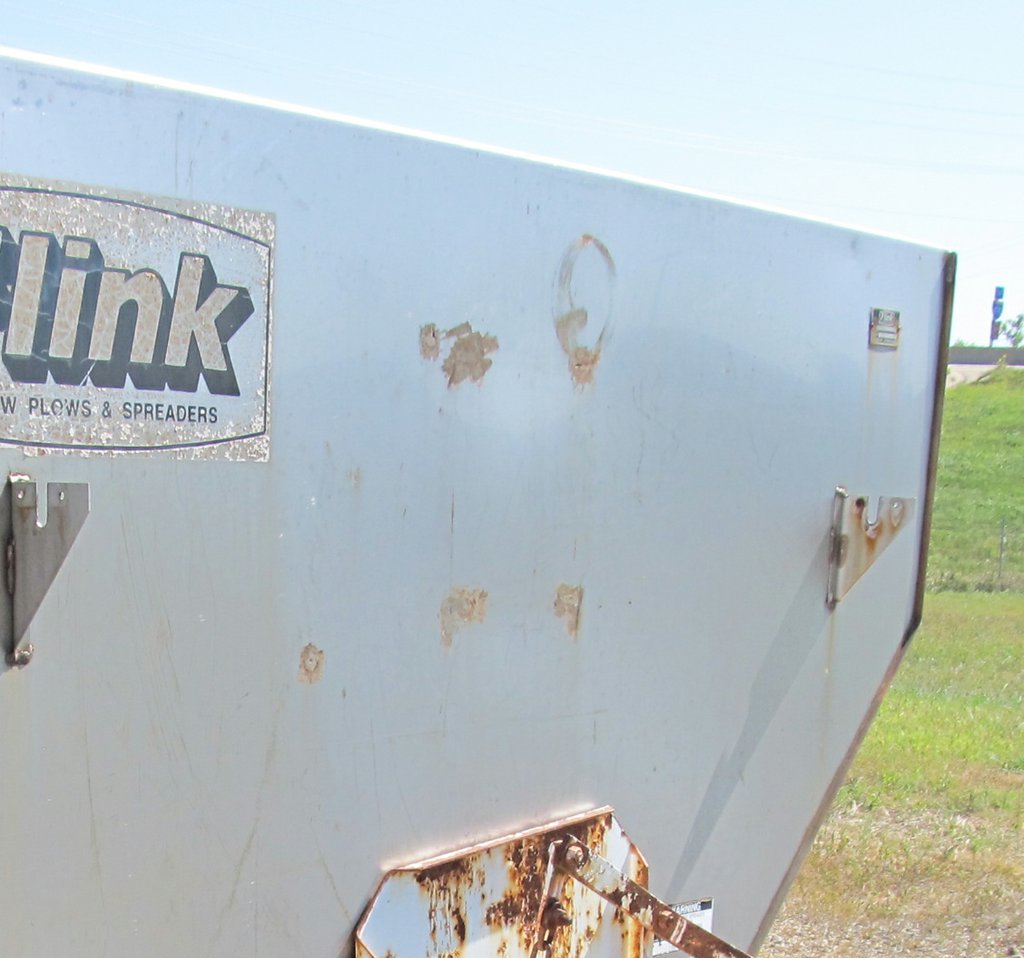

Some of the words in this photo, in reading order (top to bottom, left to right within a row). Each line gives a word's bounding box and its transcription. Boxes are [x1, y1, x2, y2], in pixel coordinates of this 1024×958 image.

[29, 397, 92, 418] PLOWS
[101, 400, 112, 419] &
[122, 401, 218, 424] SPREADERS
